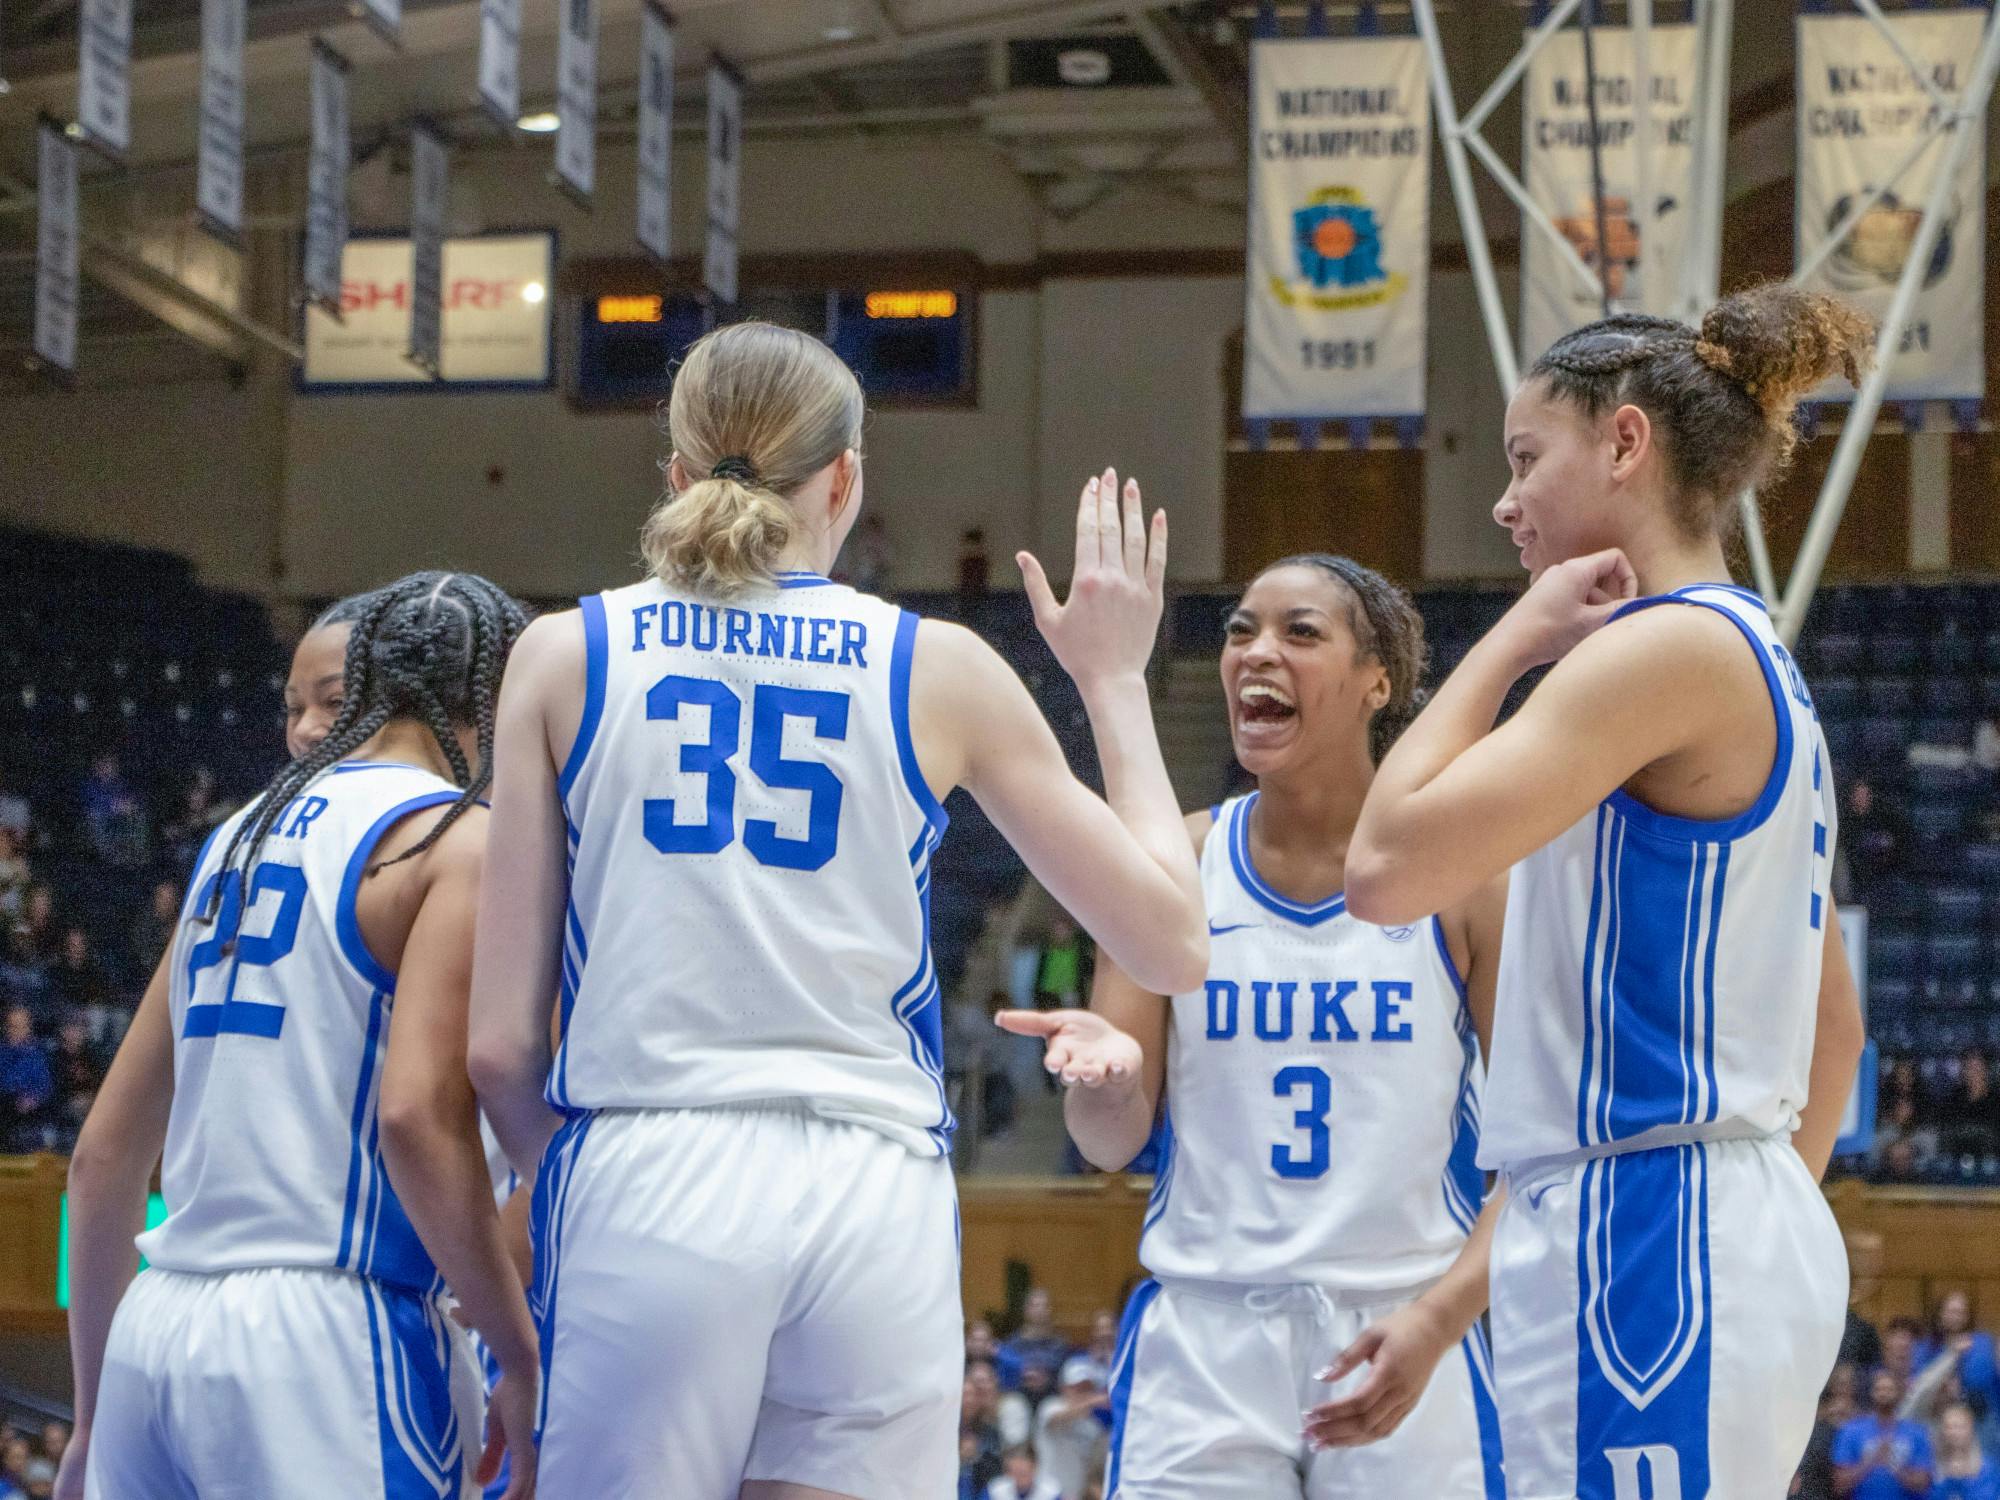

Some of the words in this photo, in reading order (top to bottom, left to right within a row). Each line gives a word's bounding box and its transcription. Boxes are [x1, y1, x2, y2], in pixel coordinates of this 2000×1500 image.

[1277, 88, 1408, 116] NATIONAL
[1263, 128, 1418, 158] CHAMPIONS
[1301, 340, 1376, 370] 1991
[632, 601, 868, 669] FOURNIER
[643, 674, 850, 872] 35
[182, 861, 308, 1040] 22
[1204, 980, 1413, 1042] DUKE
[1271, 1066, 1331, 1180] 3
